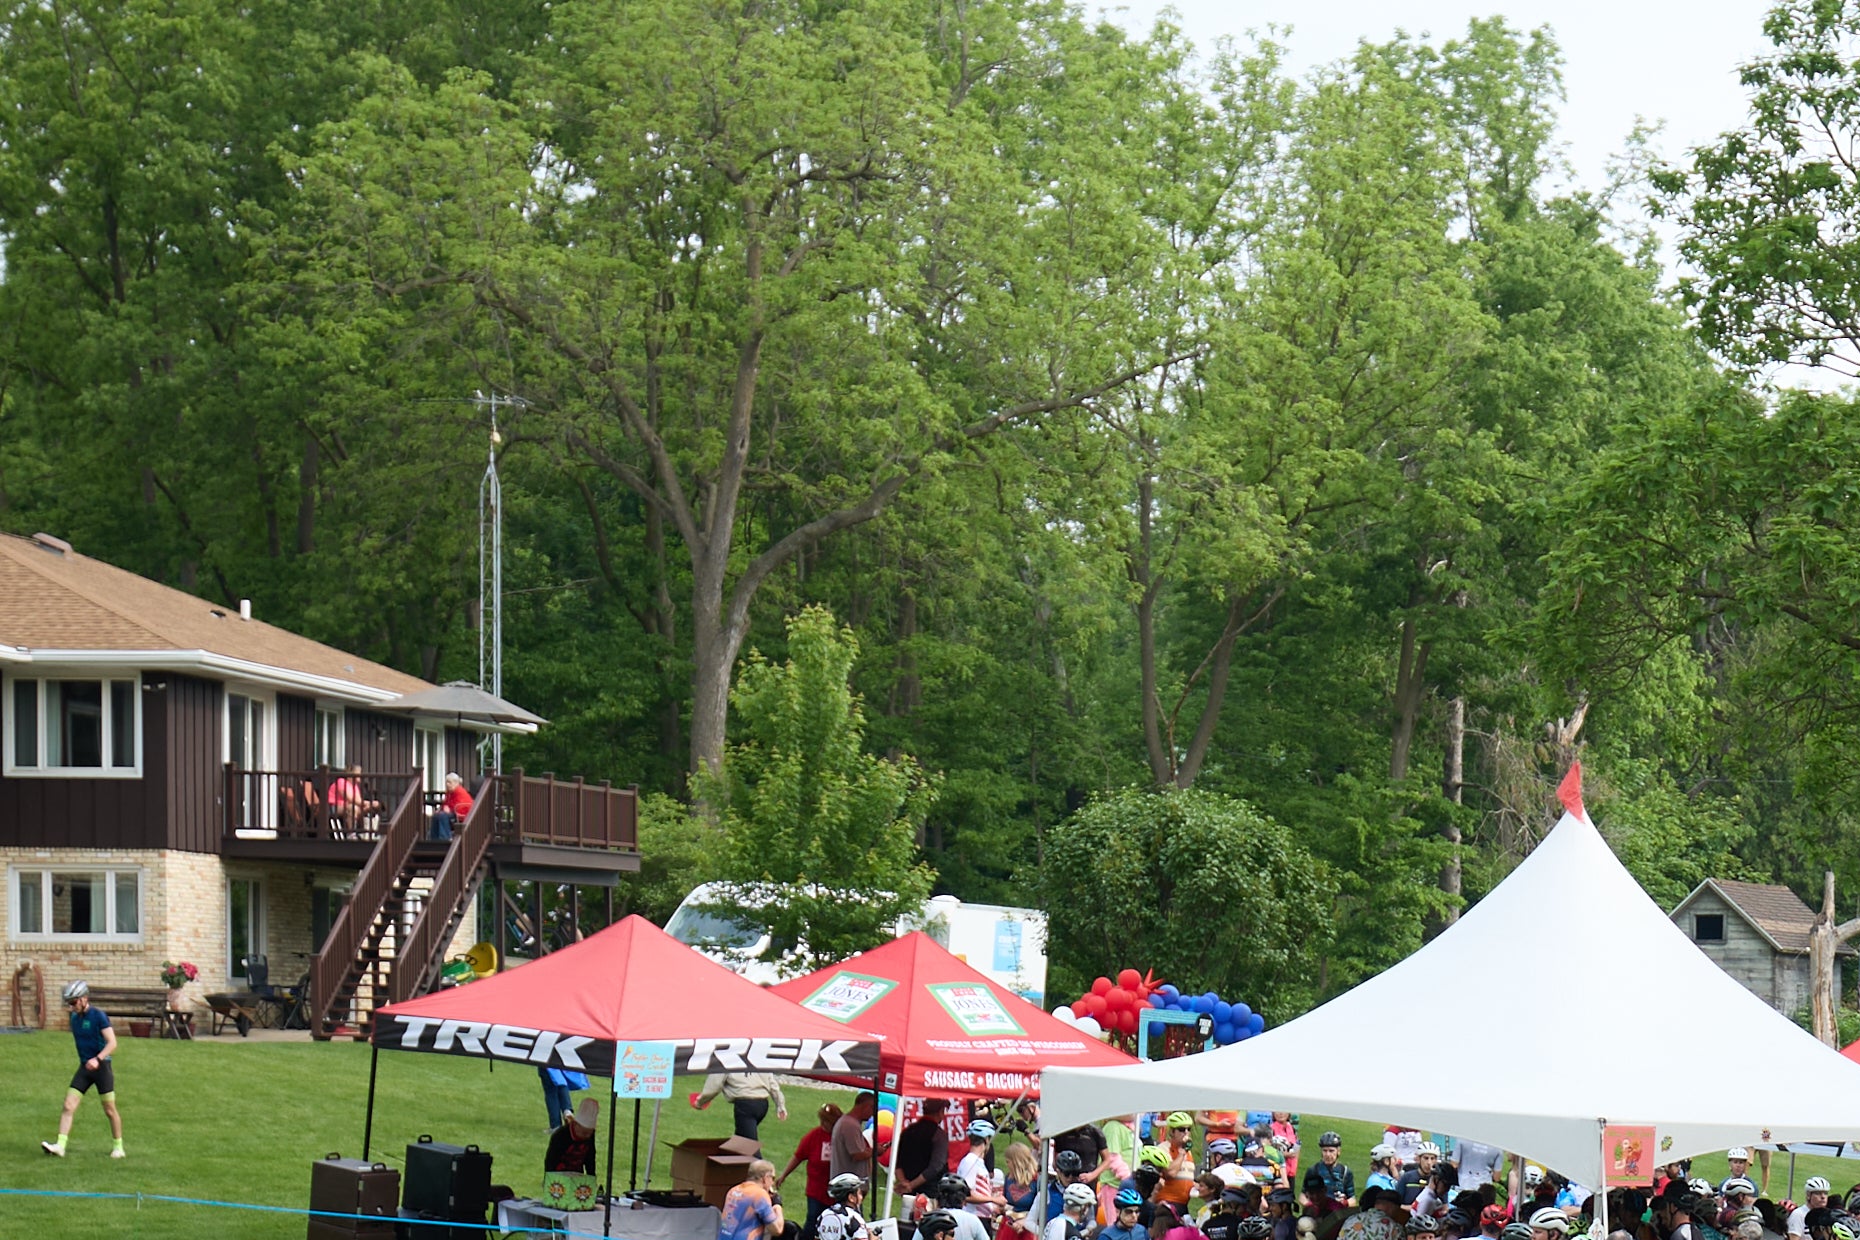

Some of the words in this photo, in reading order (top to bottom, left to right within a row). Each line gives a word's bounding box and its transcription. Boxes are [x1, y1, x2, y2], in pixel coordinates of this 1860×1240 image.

[827, 986, 871, 1001] JONES
[952, 998, 997, 1011] JONES
[394, 1015, 595, 1070] TREK
[924, 1070, 976, 1089] SAUSAGE
[985, 1072, 1023, 1090] BACON
[821, 1224, 840, 1234] RAW
